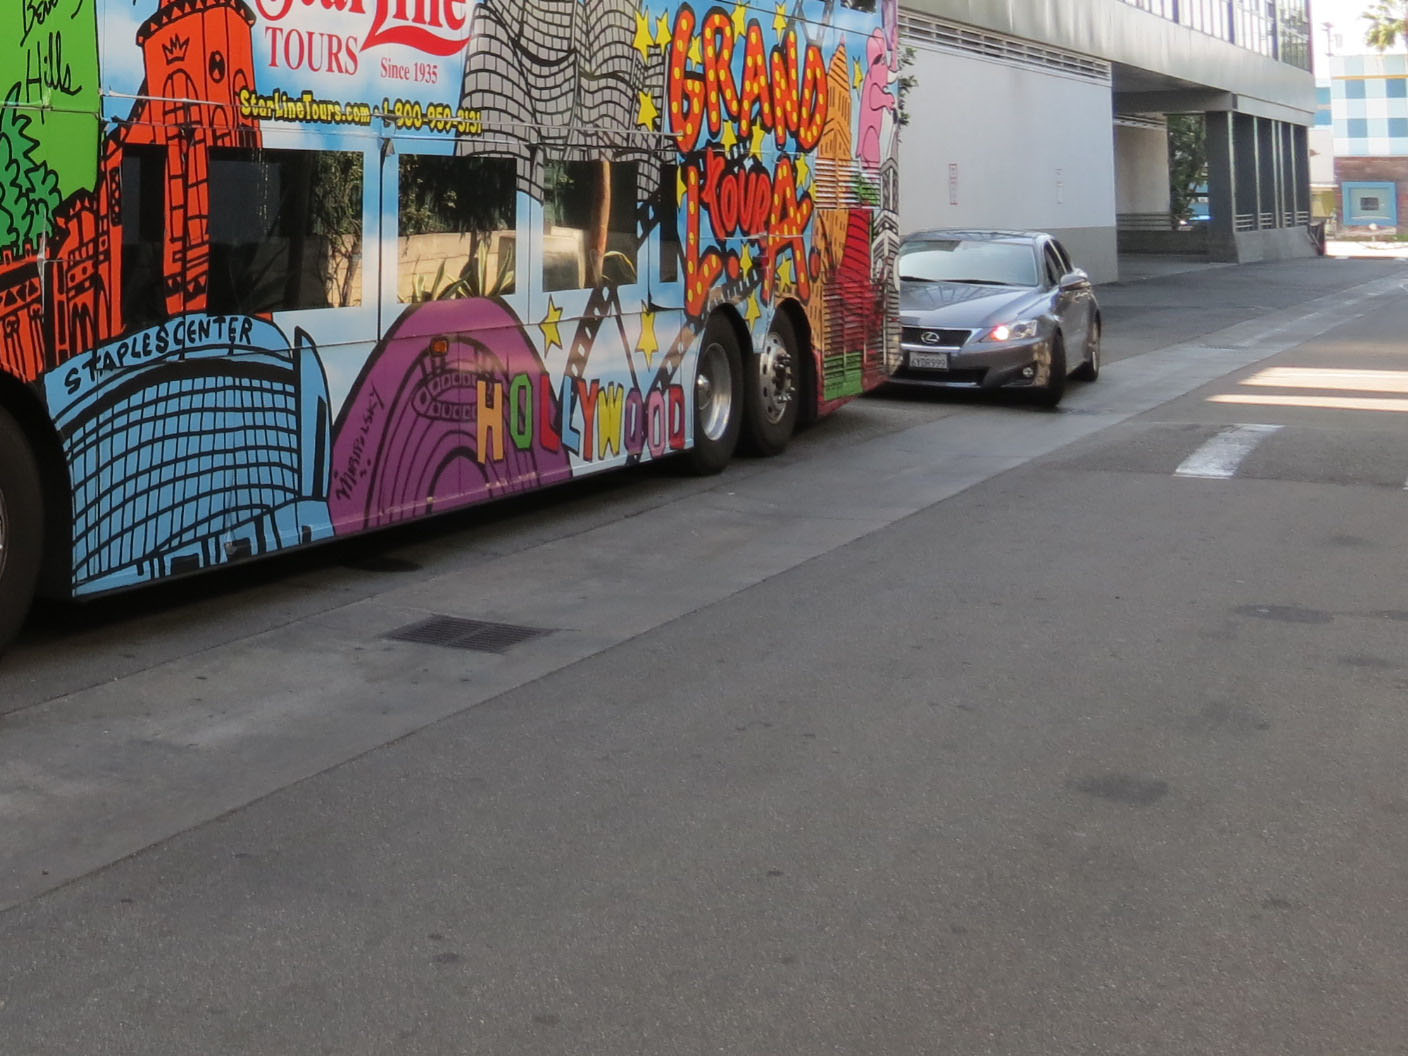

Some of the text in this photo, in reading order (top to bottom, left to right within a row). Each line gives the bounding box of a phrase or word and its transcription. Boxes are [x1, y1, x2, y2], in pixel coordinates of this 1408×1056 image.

[25, 30, 82, 106] Hills
[264, 26, 359, 76] TOURS
[380, 57, 439, 84] Since 1935
[668, 1, 830, 154] GRAND
[239, 89, 372, 125] StarLineTours.com
[700, 142, 772, 242] TOUR
[64, 317, 253, 395] STAPLES CENTER
[475, 372, 687, 465] HOLLYWOOD
